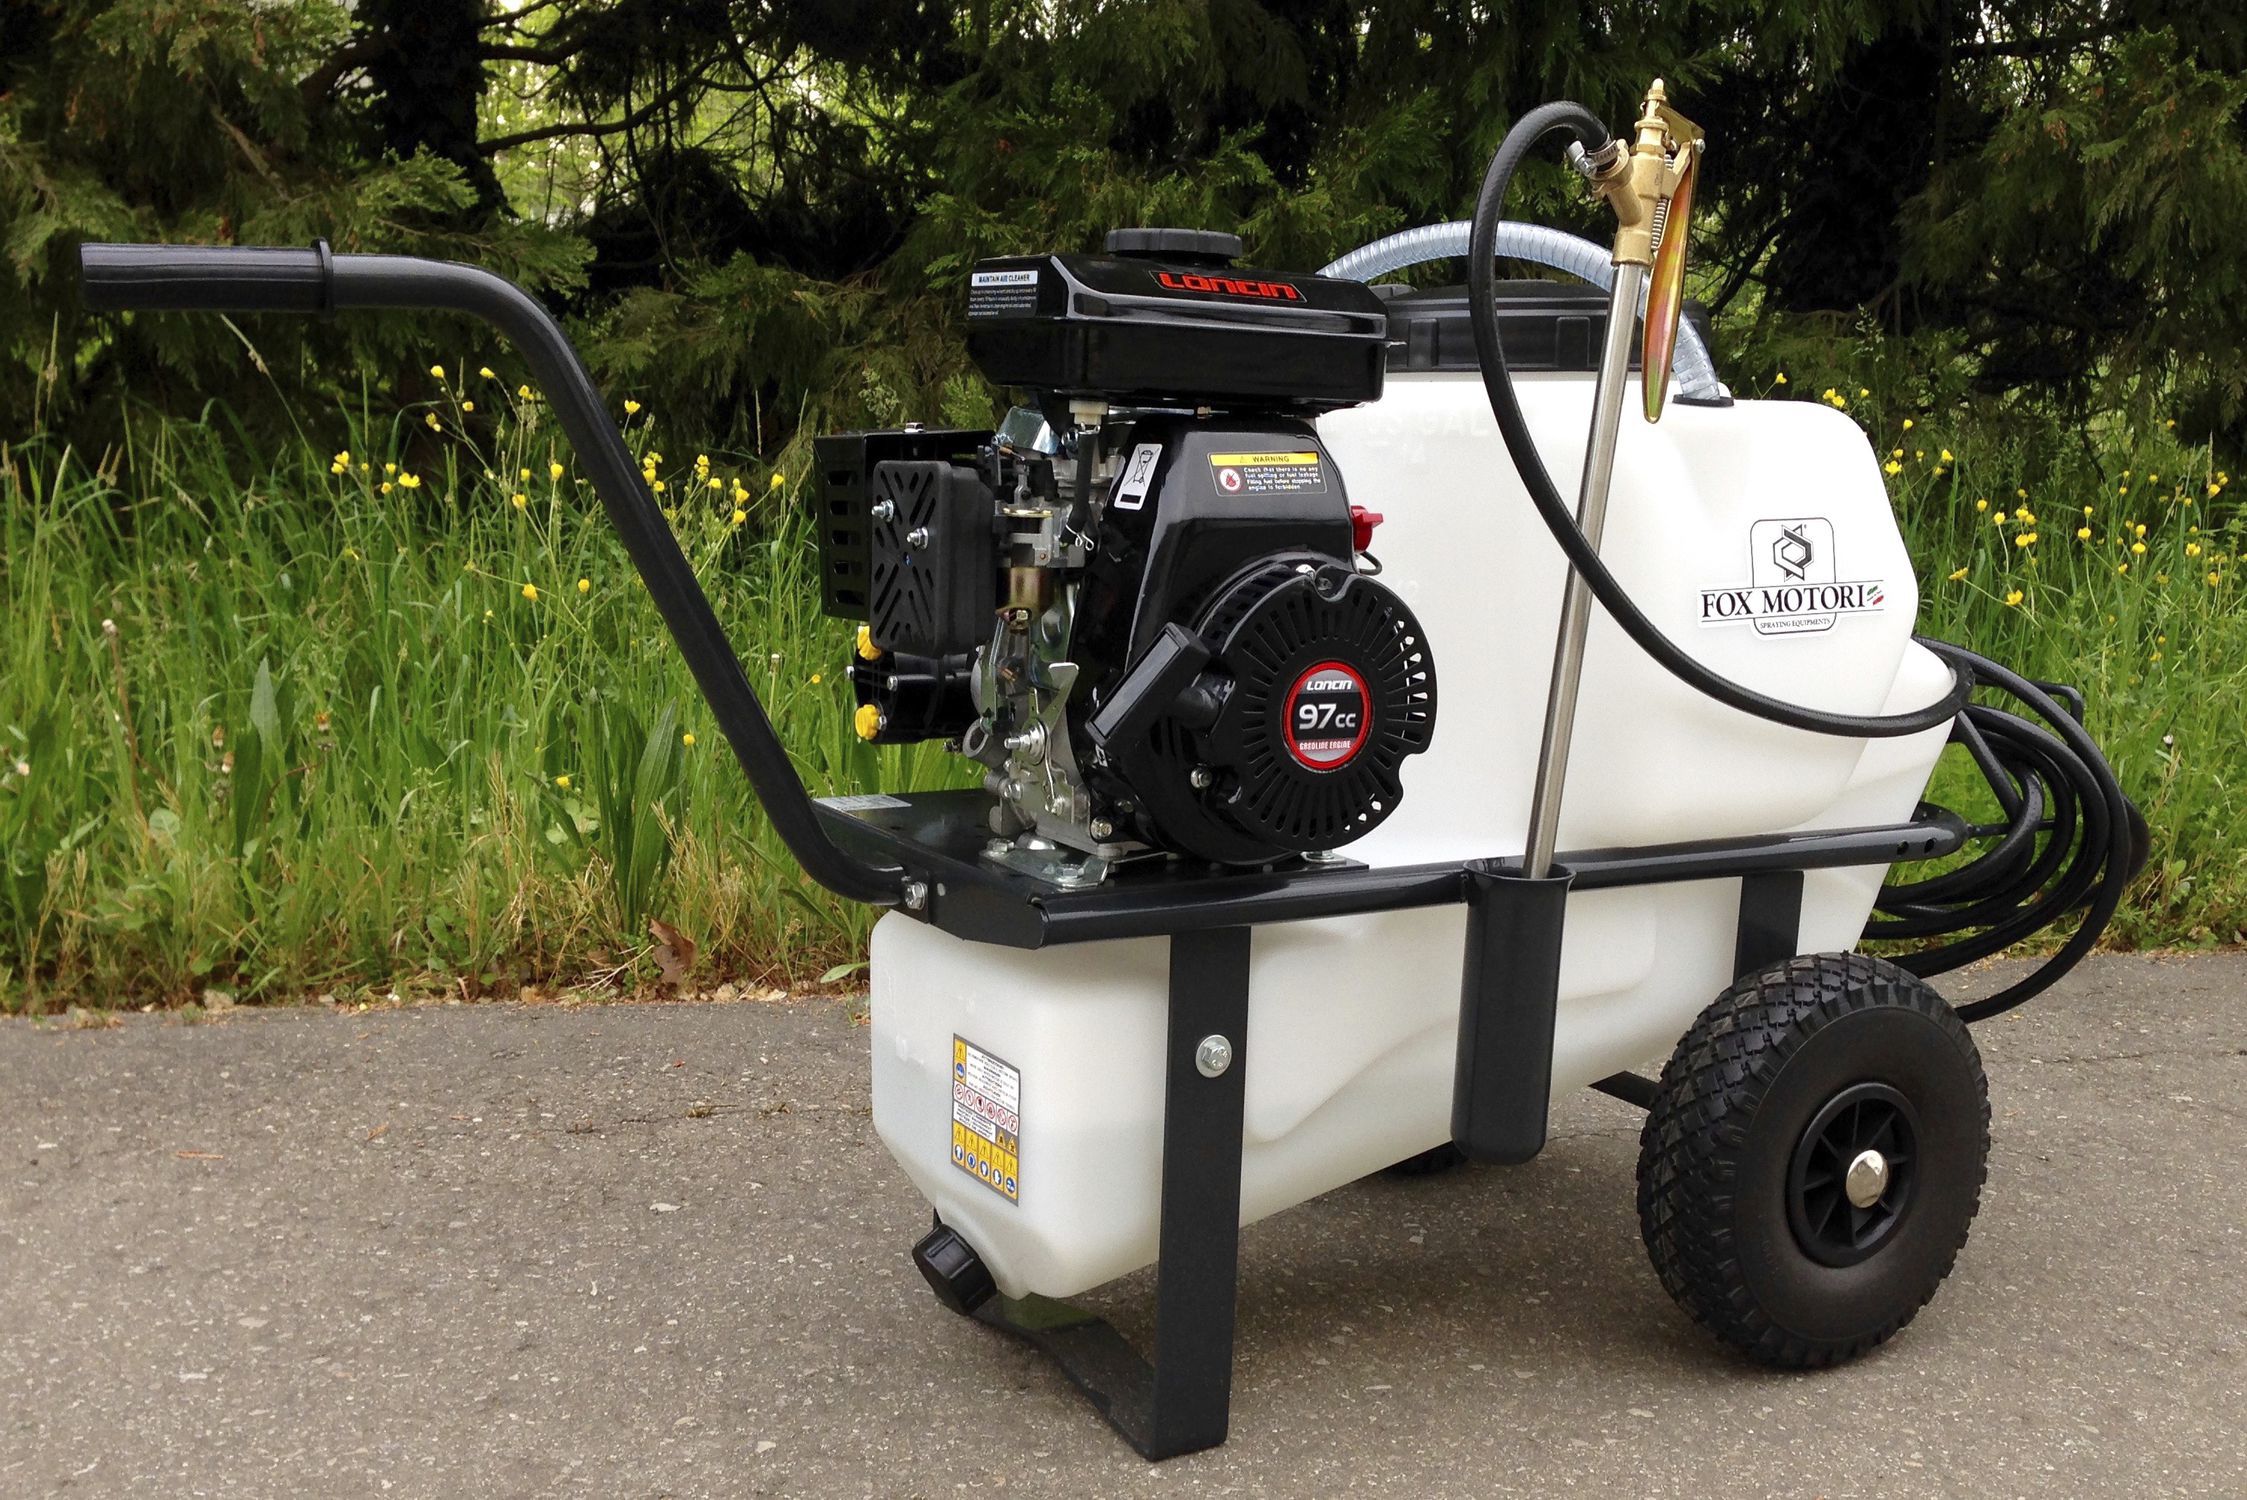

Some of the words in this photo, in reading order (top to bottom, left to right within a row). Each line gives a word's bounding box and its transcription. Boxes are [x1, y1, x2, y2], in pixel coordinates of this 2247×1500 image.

[979, 275, 1000, 283] MAINTAIN
[1008, 274, 1030, 282] CLEANER
[1158, 271, 1297, 299] LONCIN
[1702, 591, 1753, 618] FOX
[1762, 584, 1865, 614] MOTORI
[1760, 620, 1791, 629] SPRAYING
[1792, 617, 1831, 627] EQUIPMENTS
[1306, 680, 1352, 691] LONCIN
[1299, 741, 1329, 751] GASOLINE
[1329, 740, 1351, 749] ENGINE
